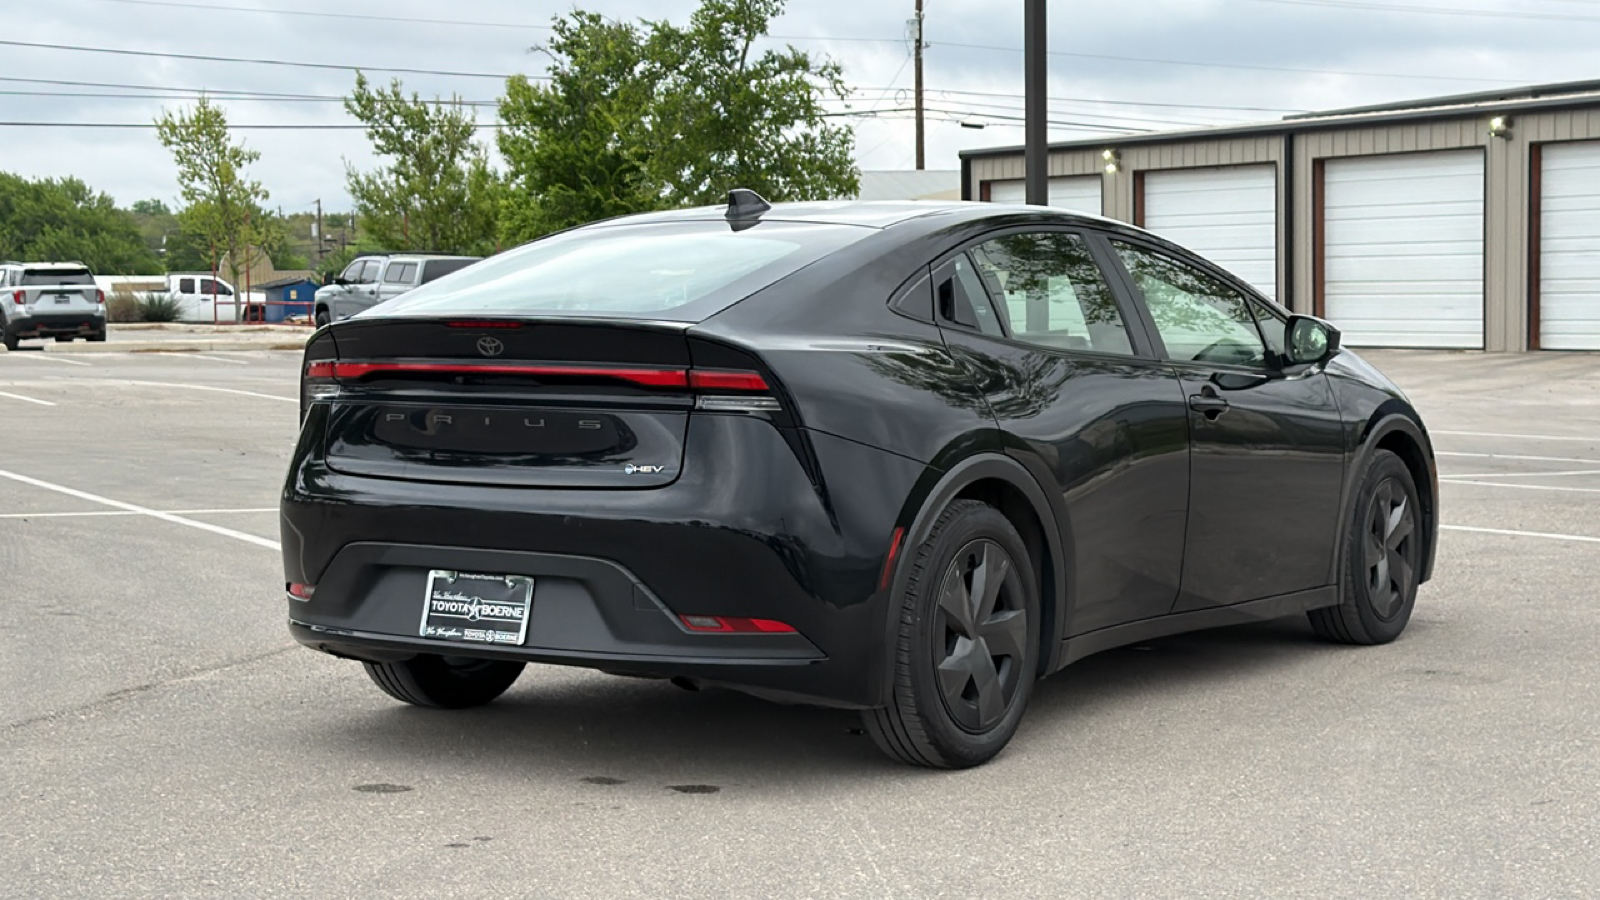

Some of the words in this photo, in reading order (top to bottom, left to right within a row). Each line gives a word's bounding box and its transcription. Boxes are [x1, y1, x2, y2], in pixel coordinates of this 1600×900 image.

[386, 413, 601, 430] PRIUS
[633, 465, 665, 473] HEV
[431, 600, 470, 613] TOYOTA
[481, 604, 524, 618] BOERNE
